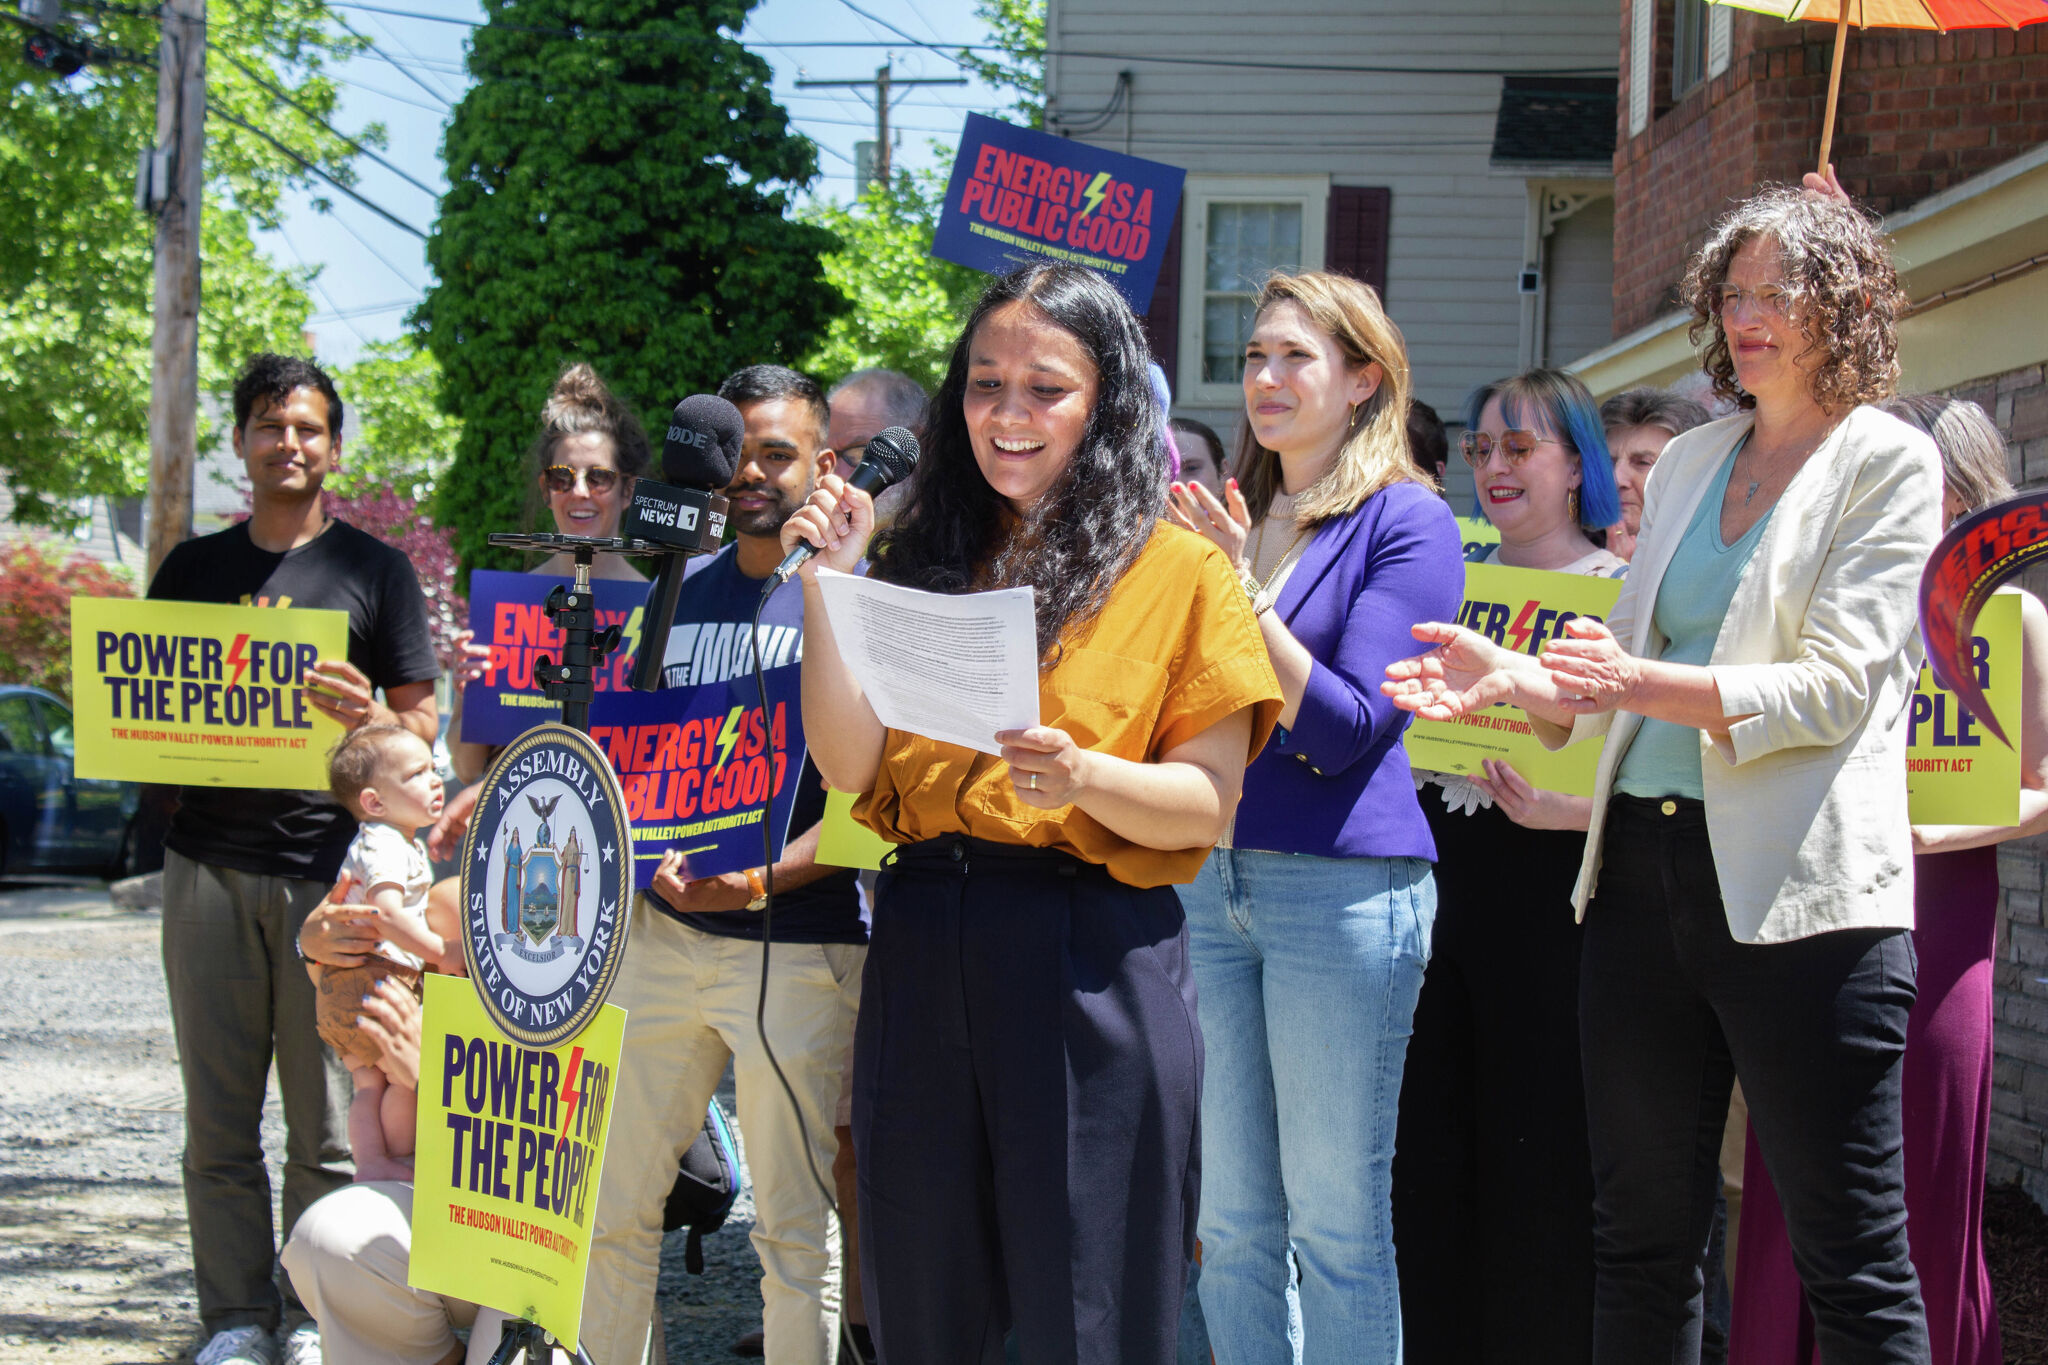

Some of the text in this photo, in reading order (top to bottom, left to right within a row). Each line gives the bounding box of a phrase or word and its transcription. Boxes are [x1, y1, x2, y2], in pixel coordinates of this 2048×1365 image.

[974, 143, 1154, 226] ENERGY IS A
[960, 178, 1151, 261] PUBLIC GOOD
[969, 222, 985, 234] THE
[984, 225, 1015, 245] HUDSON
[1014, 236, 1042, 252] VALLEY
[1041, 244, 1069, 259] POWER
[1110, 262, 1128, 275] ACT
[634, 495, 678, 513] SPECTRUM
[640, 508, 675, 527] NEWS
[1972, 551, 2016, 588] VALLEY
[96, 631, 319, 687] POWER FOR
[672, 666, 691, 687] THE
[104, 676, 313, 730] THE PEOPLE
[499, 693, 518, 706] THE
[1459, 714, 1490, 729] POWER
[1907, 693, 1981, 746] PLE
[111, 728, 308, 749] THE HUDSON VALLEY POWER AUTHORITY ACT
[733, 706, 767, 759] IS
[770, 701, 787, 750] A
[498, 750, 604, 811] ASSEMBLY
[619, 752, 788, 821] BLIC GOOD
[1906, 758, 1973, 773] HORITY ACT
[641, 826, 675, 841] VALLEY
[674, 821, 704, 840] POWER
[703, 812, 748, 834] AUTHORITY
[746, 809, 765, 825] ACT
[470, 892, 616, 1027] STATE OF NEW YORK
[520, 949, 556, 962] EXCELSIOR
[441, 1033, 610, 1147] POWER FOR
[447, 1112, 595, 1229] THE PEOPLE
[448, 1204, 467, 1226] THE
[466, 1208, 501, 1234] HUDSON
[502, 1216, 530, 1241] VALLEY
[529, 1224, 553, 1249] POWER
